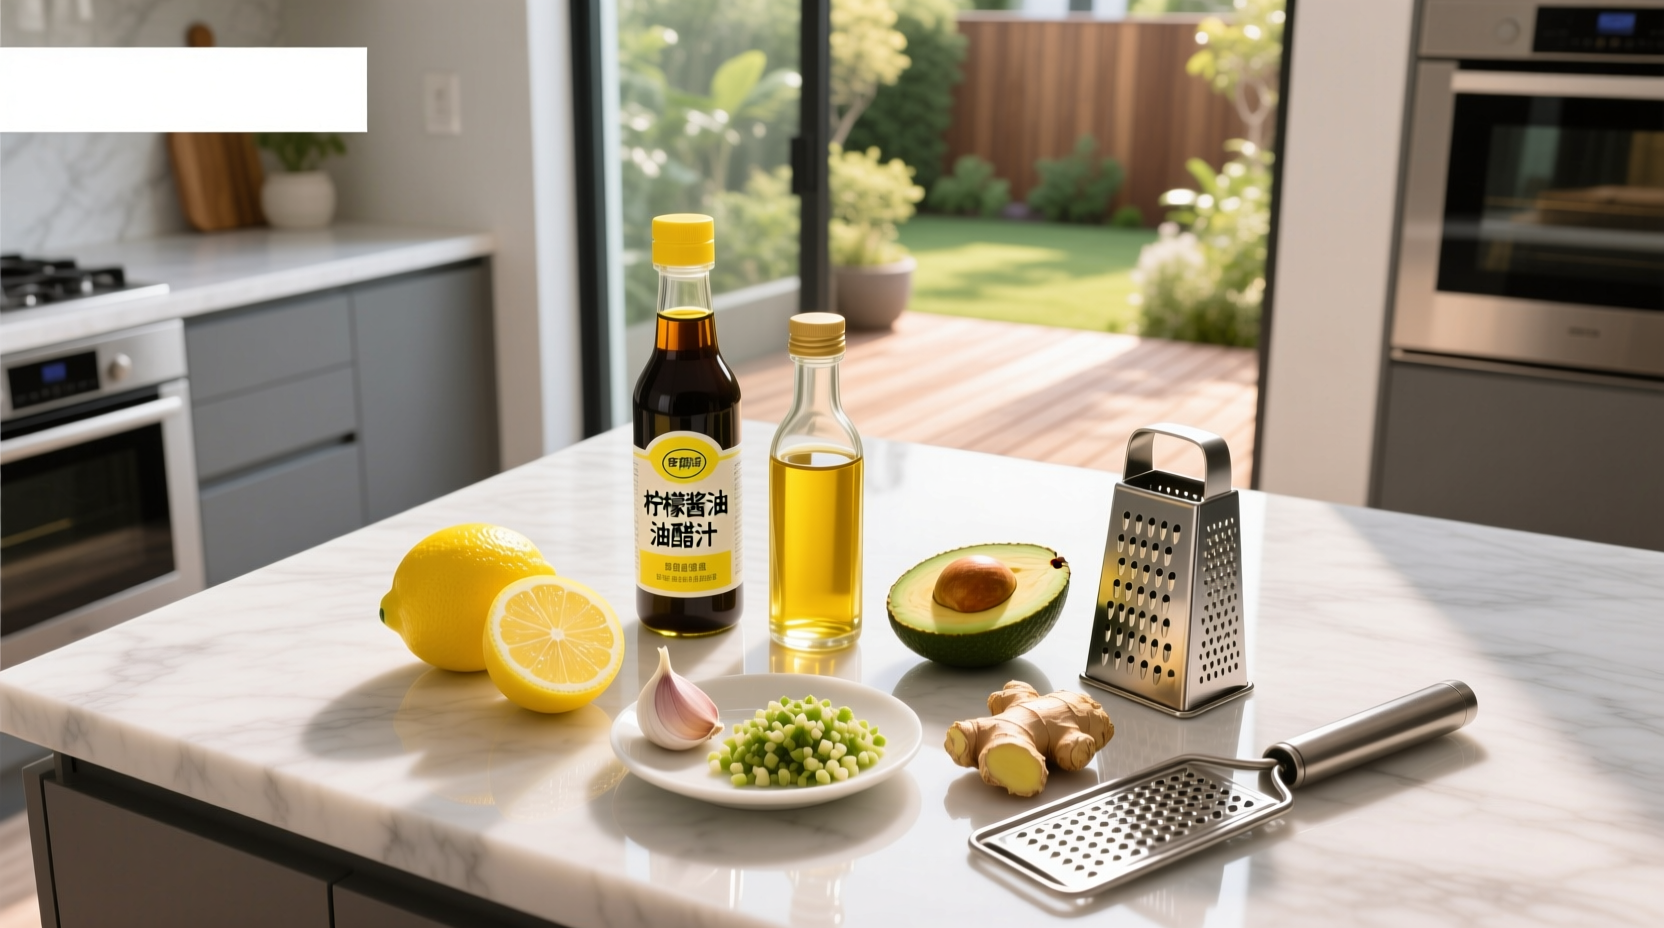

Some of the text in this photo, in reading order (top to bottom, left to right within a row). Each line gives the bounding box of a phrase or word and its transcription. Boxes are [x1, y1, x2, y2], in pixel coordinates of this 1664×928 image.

[644, 489, 728, 518] 柠檬酱油
[650, 521, 717, 548] 油醋汁
